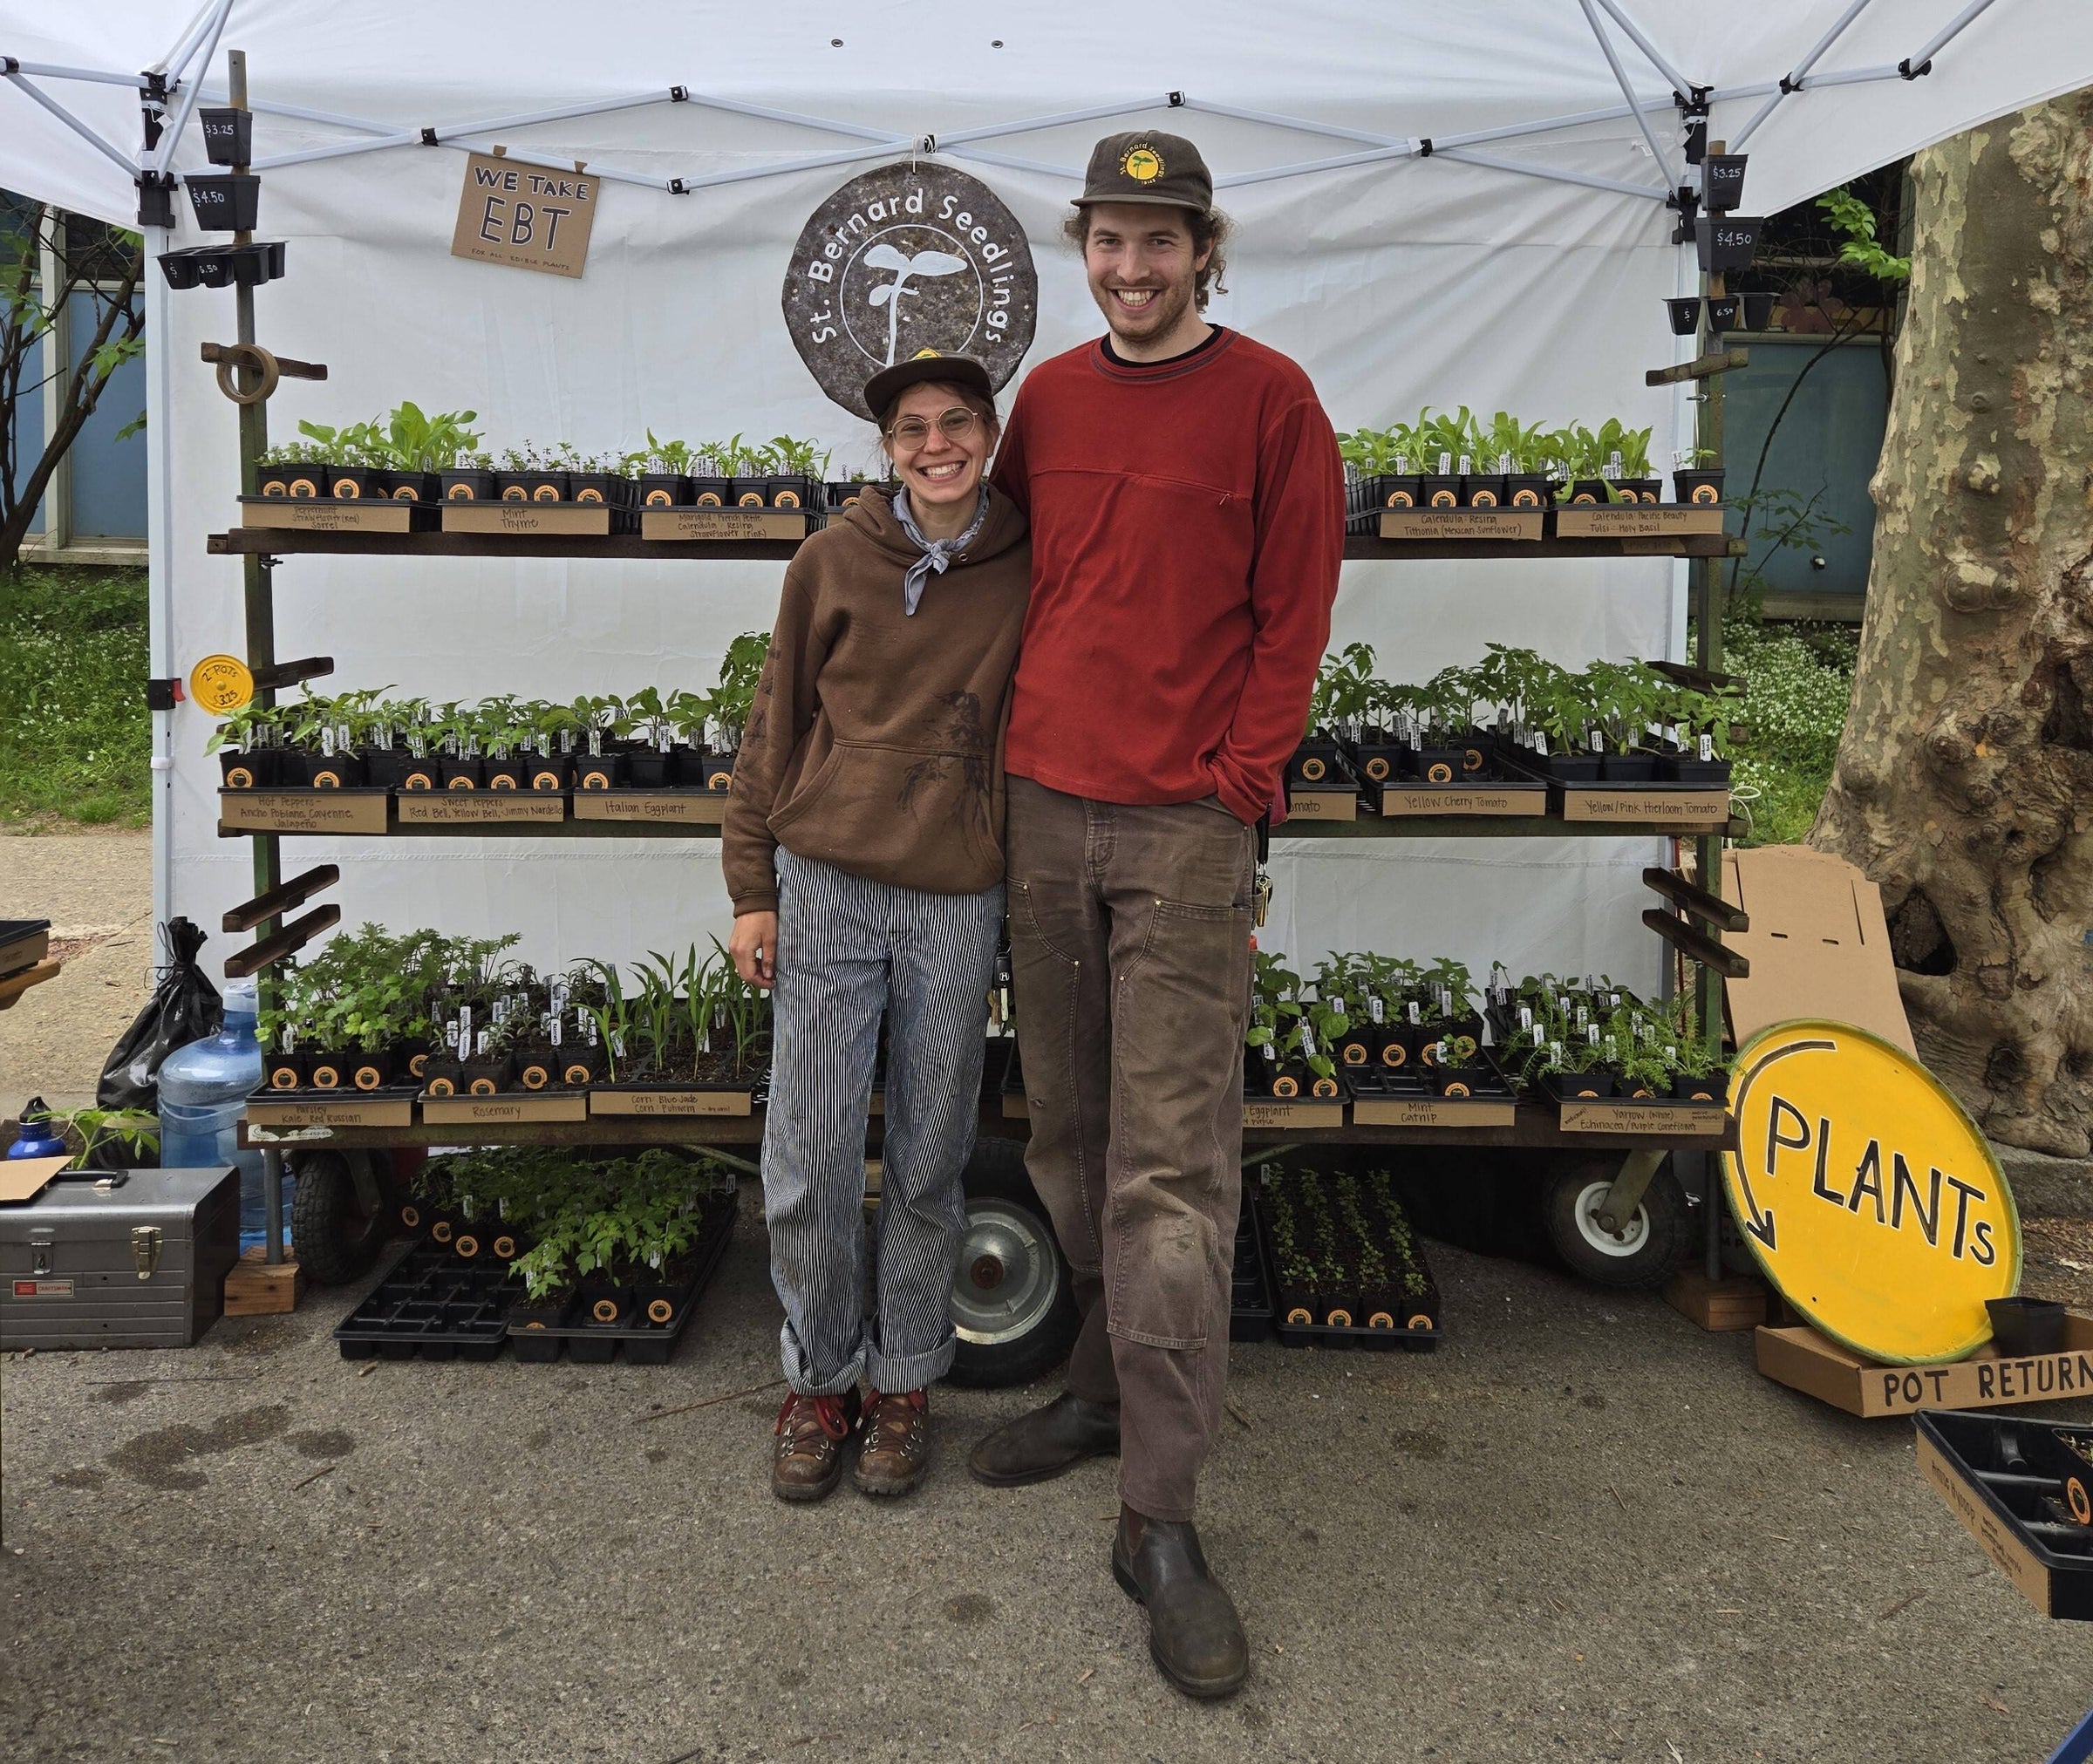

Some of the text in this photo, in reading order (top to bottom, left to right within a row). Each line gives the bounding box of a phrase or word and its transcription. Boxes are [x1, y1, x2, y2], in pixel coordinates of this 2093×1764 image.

[205, 120, 234, 138] $3.25
[1120, 142, 1148, 162] Bernard
[1713, 165, 1742, 180] $3.25
[474, 166, 590, 201] WE TAKE
[193, 187, 225, 208] $4.50
[480, 194, 571, 251] EBT
[1716, 228, 1752, 248] $4.50
[510, 255, 538, 265] EDIBLE
[542, 260, 570, 270] PLANTS
[807, 188, 1014, 344] St. Bernard Seedlings
[502, 508, 527, 519] Mint
[717, 513, 740, 522] French
[1638, 511, 1660, 521] Pacific
[1663, 511, 1687, 522] Beauty
[501, 518, 539, 531] Thyme
[1590, 523, 1660, 534] Tulsi Holy Basil
[1404, 526, 1439, 536] Tithonia
[1442, 526, 1476, 538] (Mexican
[258, 796, 276, 806] Hot
[441, 797, 469, 807] Sweet
[1404, 795, 1507, 809] Yellow Cherry Tomato
[1683, 801, 1718, 814] Tomato
[240, 808, 268, 819] Ancho
[409, 804, 563, 819] Red Bell, Yellow Bell, Jimmy Nardello
[605, 801, 687, 817] Italian Eggplant
[274, 819, 317, 829] Jalapeño
[658, 1093, 678, 1104] Blue
[678, 1093, 698, 1104] Jade
[296, 1106, 327, 1115] Parsley
[472, 1106, 522, 1120] Rosemary
[1250, 1105, 1294, 1119] Eggplant
[1408, 1103, 1434, 1113] Mint
[1613, 1109, 1645, 1120] Yarrow
[310, 1114, 324, 1124] Red
[327, 1114, 362, 1124] Russian
[1401, 1113, 1437, 1123] Catnip
[1884, 1369, 1949, 1407] POT
